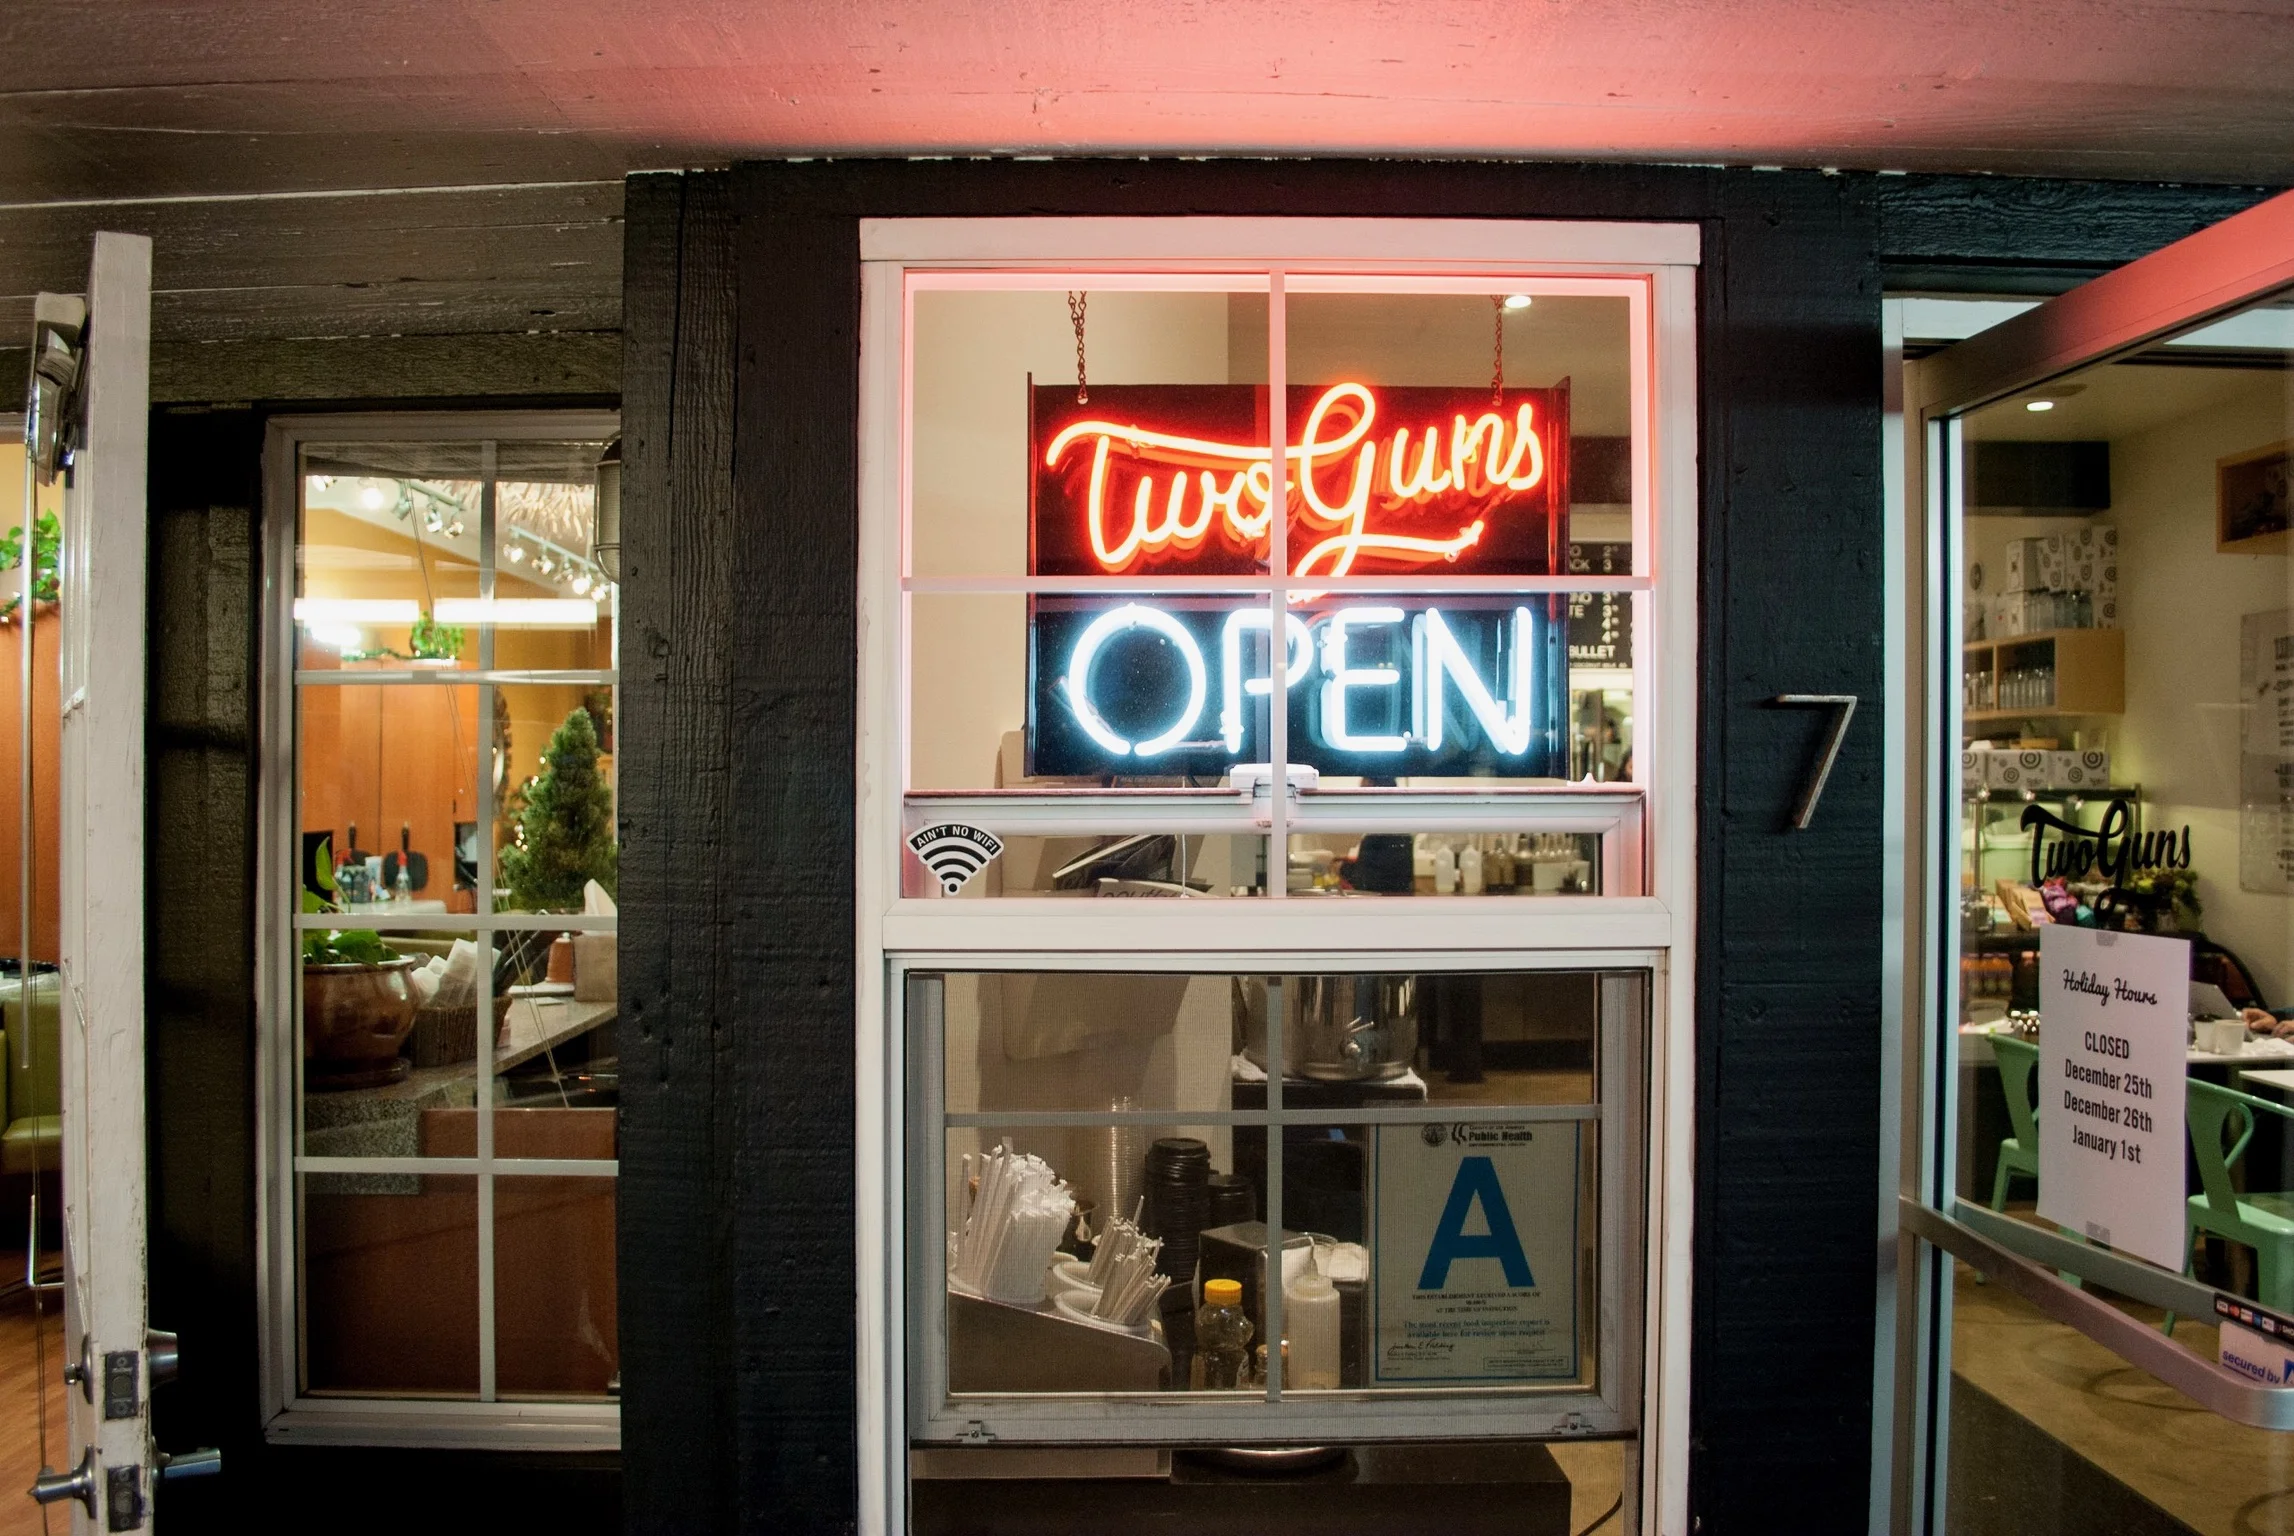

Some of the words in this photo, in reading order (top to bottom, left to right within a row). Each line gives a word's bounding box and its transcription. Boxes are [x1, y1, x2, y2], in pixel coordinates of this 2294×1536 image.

[1067, 603, 1534, 756] OPEN
[1776, 694, 1858, 829] 7
[916, 826, 947, 848] AIN'T
[952, 825, 969, 837] NO
[973, 830, 998, 853] WIFI
[2063, 968, 2109, 1006] Holiday
[2114, 977, 2158, 1005] Hours
[2084, 1031, 2130, 1060] CLOSED
[2065, 1058, 2120, 1091] December
[2123, 1073, 2153, 1100] 25th
[2064, 1090, 2120, 1125] December
[2123, 1106, 2153, 1133] 26th
[1468, 1131, 1499, 1141] Public
[1502, 1131, 1533, 1141] Health
[2073, 1124, 2117, 1161] January
[2120, 1140, 2142, 1165] 1st
[1417, 1156, 1536, 1290] A
[2222, 1349, 2266, 1377] secured
[2266, 1369, 2281, 1384] by
